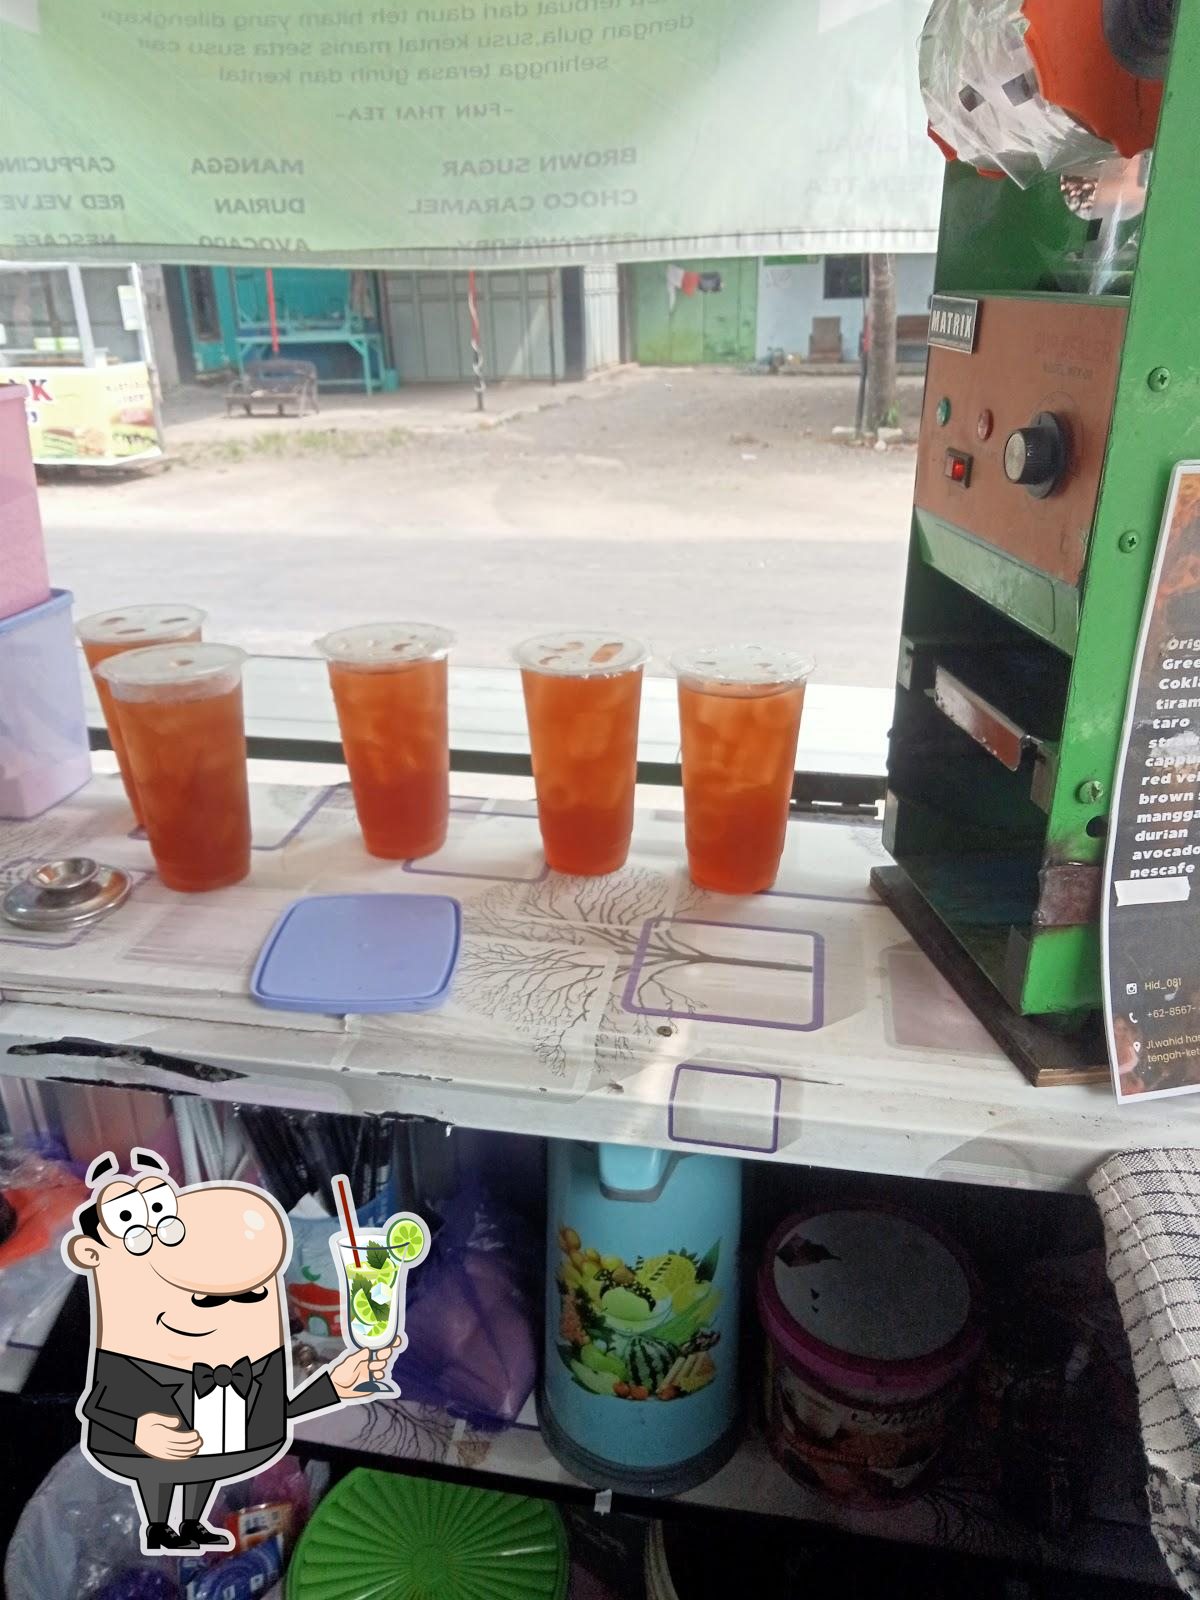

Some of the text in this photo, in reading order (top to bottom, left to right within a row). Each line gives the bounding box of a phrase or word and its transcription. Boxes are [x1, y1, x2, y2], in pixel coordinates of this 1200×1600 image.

[931, 310, 972, 339] MATRIX
[1158, 676, 1200, 690] Cokl
[1152, 718, 1191, 730] taro
[1144, 754, 1200, 768] cappu
[1141, 773, 1172, 786] red
[1138, 792, 1194, 805] brown
[1136, 810, 1200, 824] mangga
[1134, 829, 1189, 842] durian
[1132, 845, 1200, 861] avocado
[1130, 861, 1196, 878] nescafe
